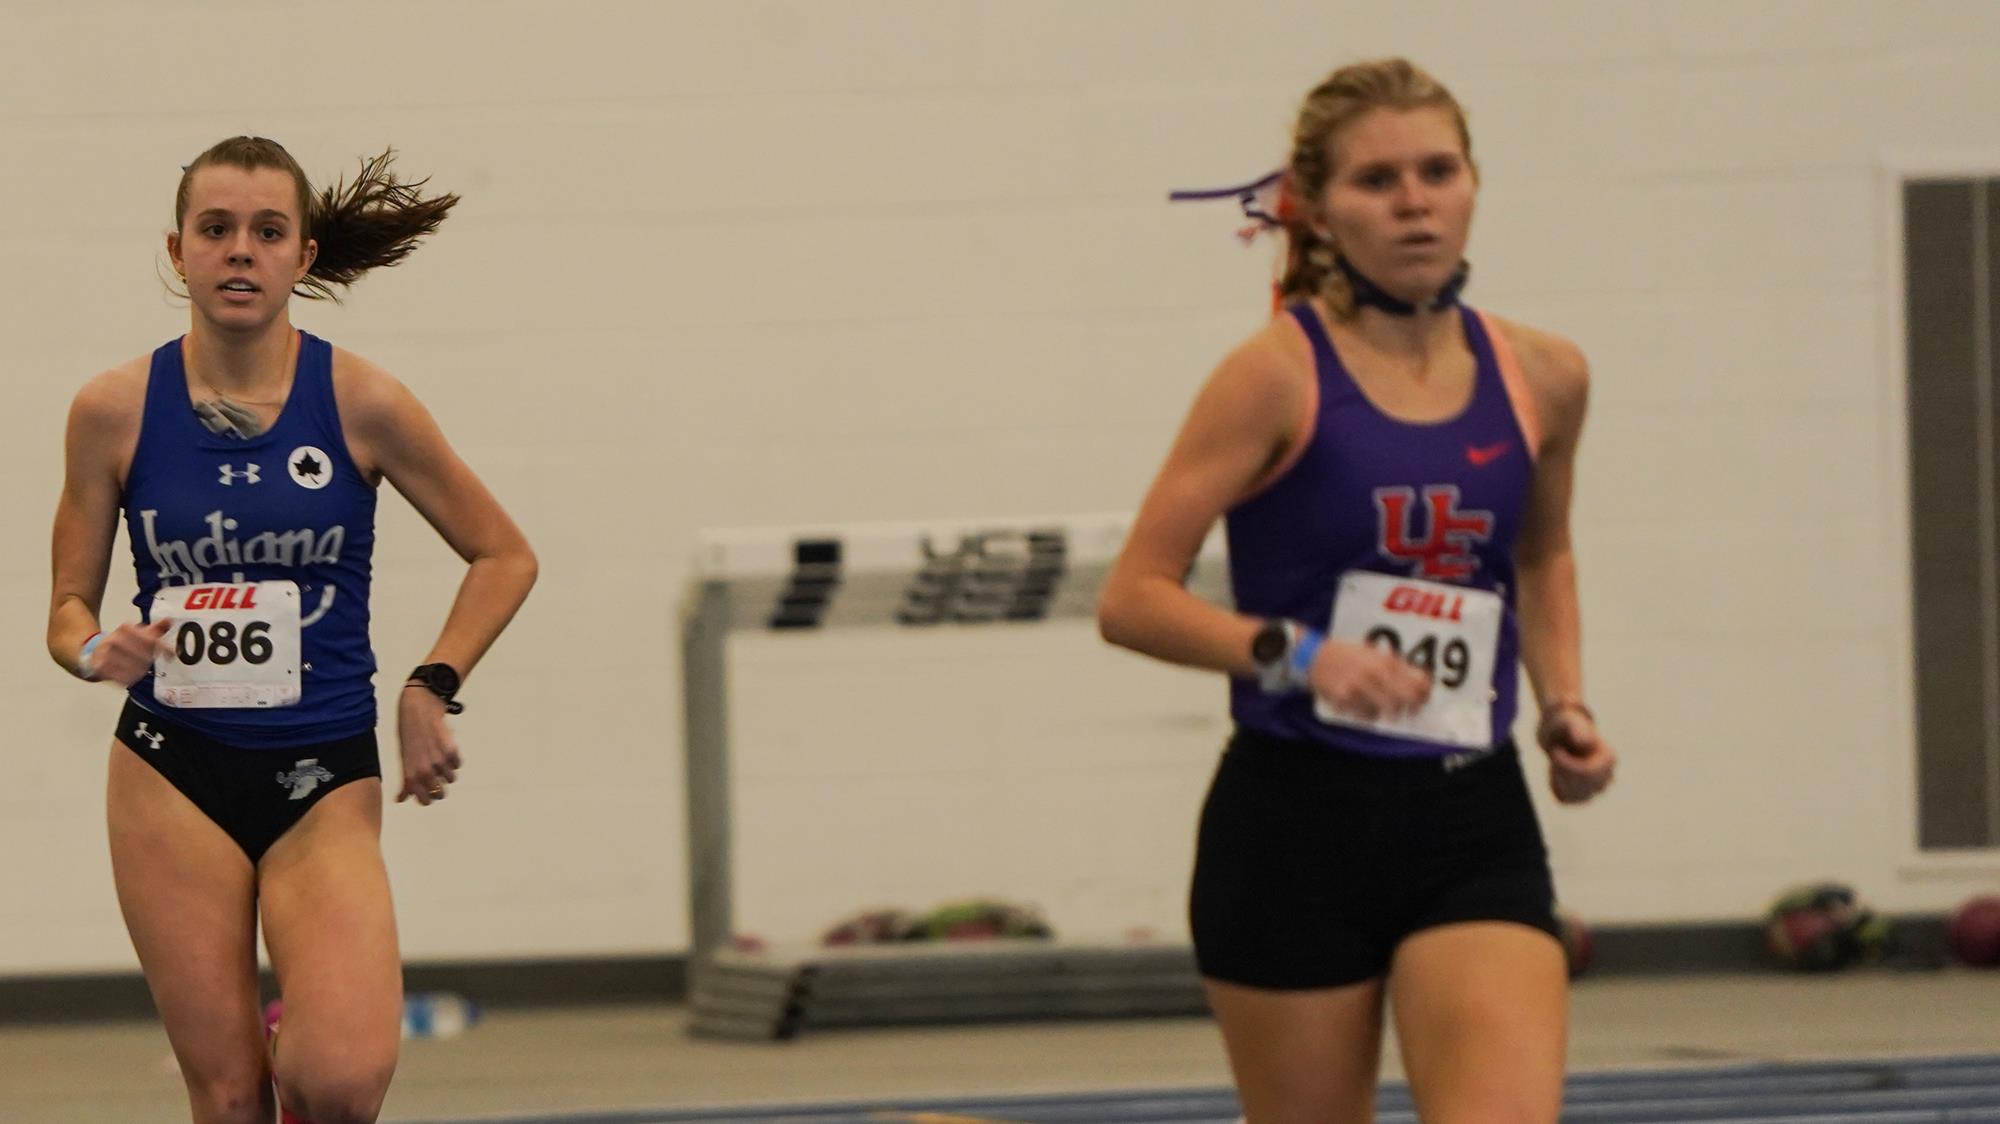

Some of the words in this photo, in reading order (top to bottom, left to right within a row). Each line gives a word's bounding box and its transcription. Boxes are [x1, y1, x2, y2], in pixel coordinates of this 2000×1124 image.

[139, 509, 345, 577] Indiana
[1372, 484, 1495, 581] UE
[184, 586, 258, 610] GILL
[1383, 586, 1464, 623] GILL
[175, 620, 274, 666] 086
